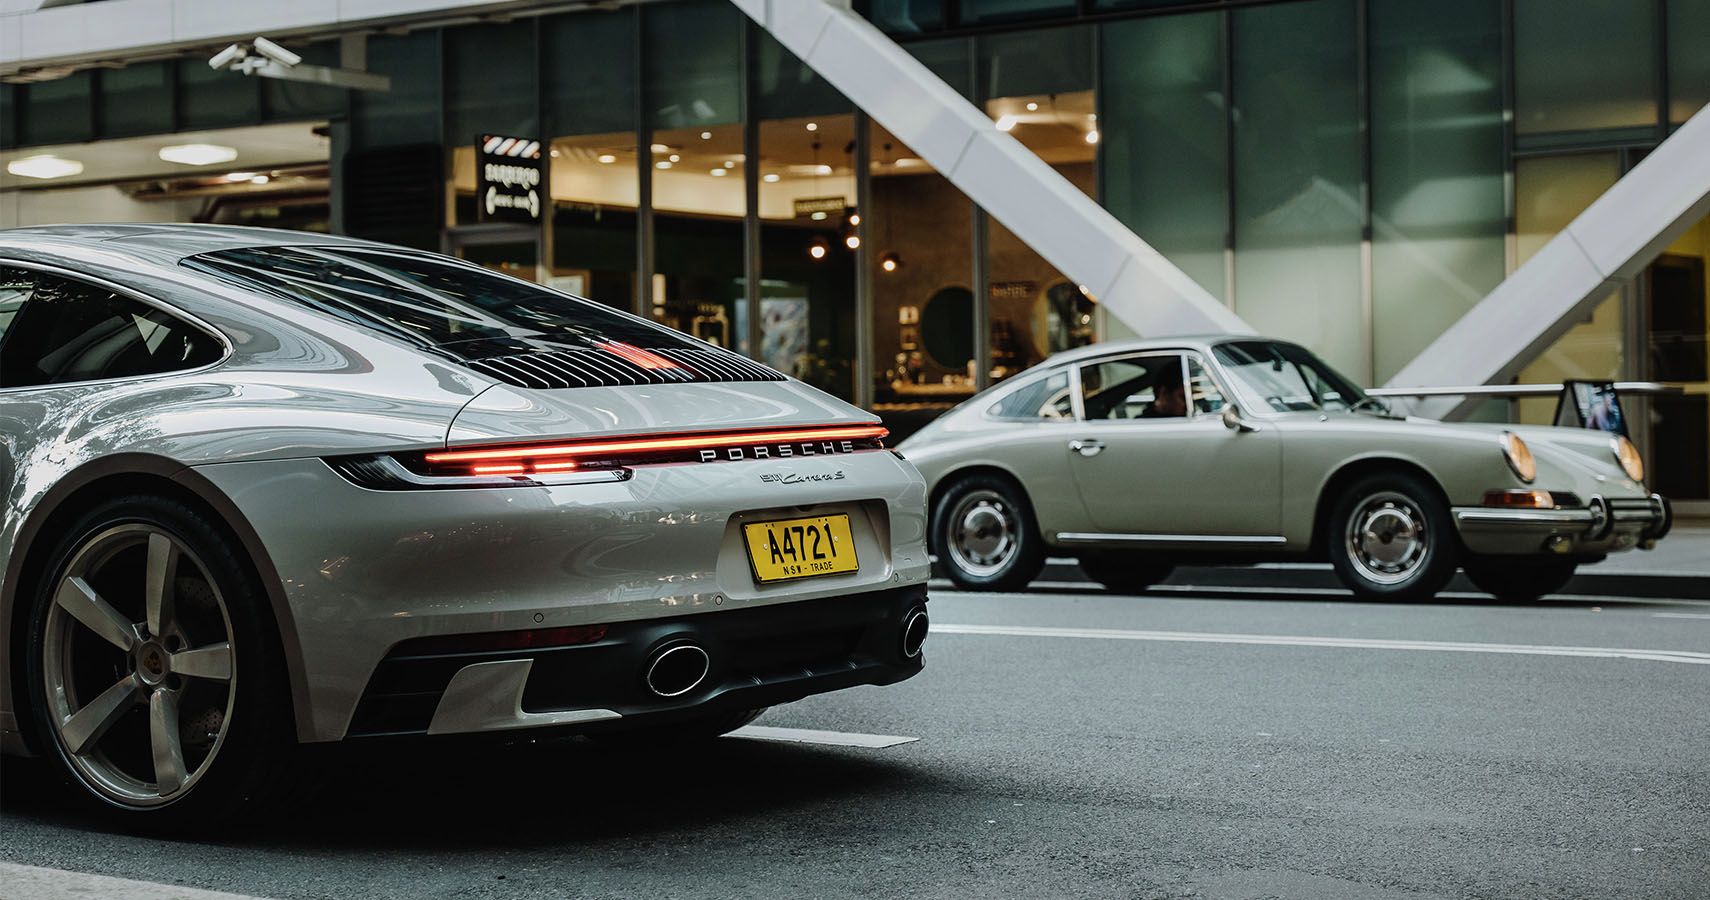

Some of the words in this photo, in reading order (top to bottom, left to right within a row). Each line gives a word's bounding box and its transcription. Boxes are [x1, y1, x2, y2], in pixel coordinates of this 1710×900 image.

[699, 440, 853, 463] PORSCHE
[780, 473, 833, 484] Carrera
[834, 470, 846, 480] S
[768, 523, 836, 565] A4721
[783, 565, 802, 576] NSW
[810, 561, 834, 572] TRADE
